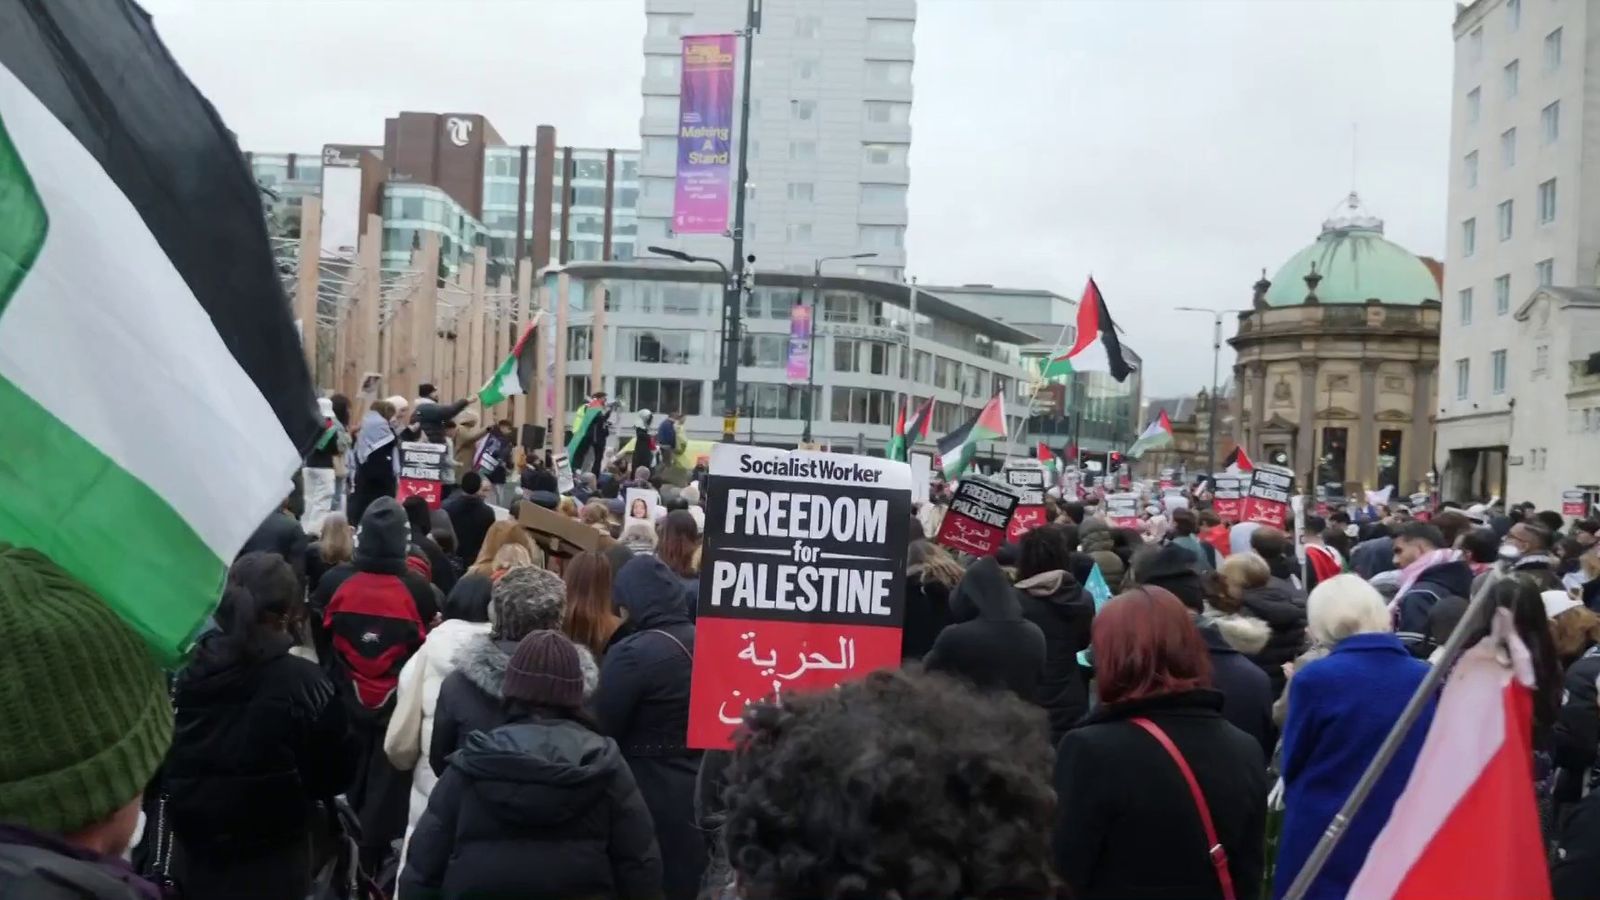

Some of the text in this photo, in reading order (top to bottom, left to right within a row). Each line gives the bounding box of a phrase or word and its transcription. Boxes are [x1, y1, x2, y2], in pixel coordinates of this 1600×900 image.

[681, 126, 729, 141] Making
[703, 139, 714, 150] A
[688, 151, 729, 165] Stand
[740, 454, 882, 483] Socialist Worker
[962, 483, 1013, 510] FREEDOM
[724, 488, 888, 544] FREEDOM
[951, 500, 1008, 528] PALESTINE
[793, 540, 821, 563] for
[710, 560, 893, 616] PALESTINE
[737, 631, 855, 680] الحرية
